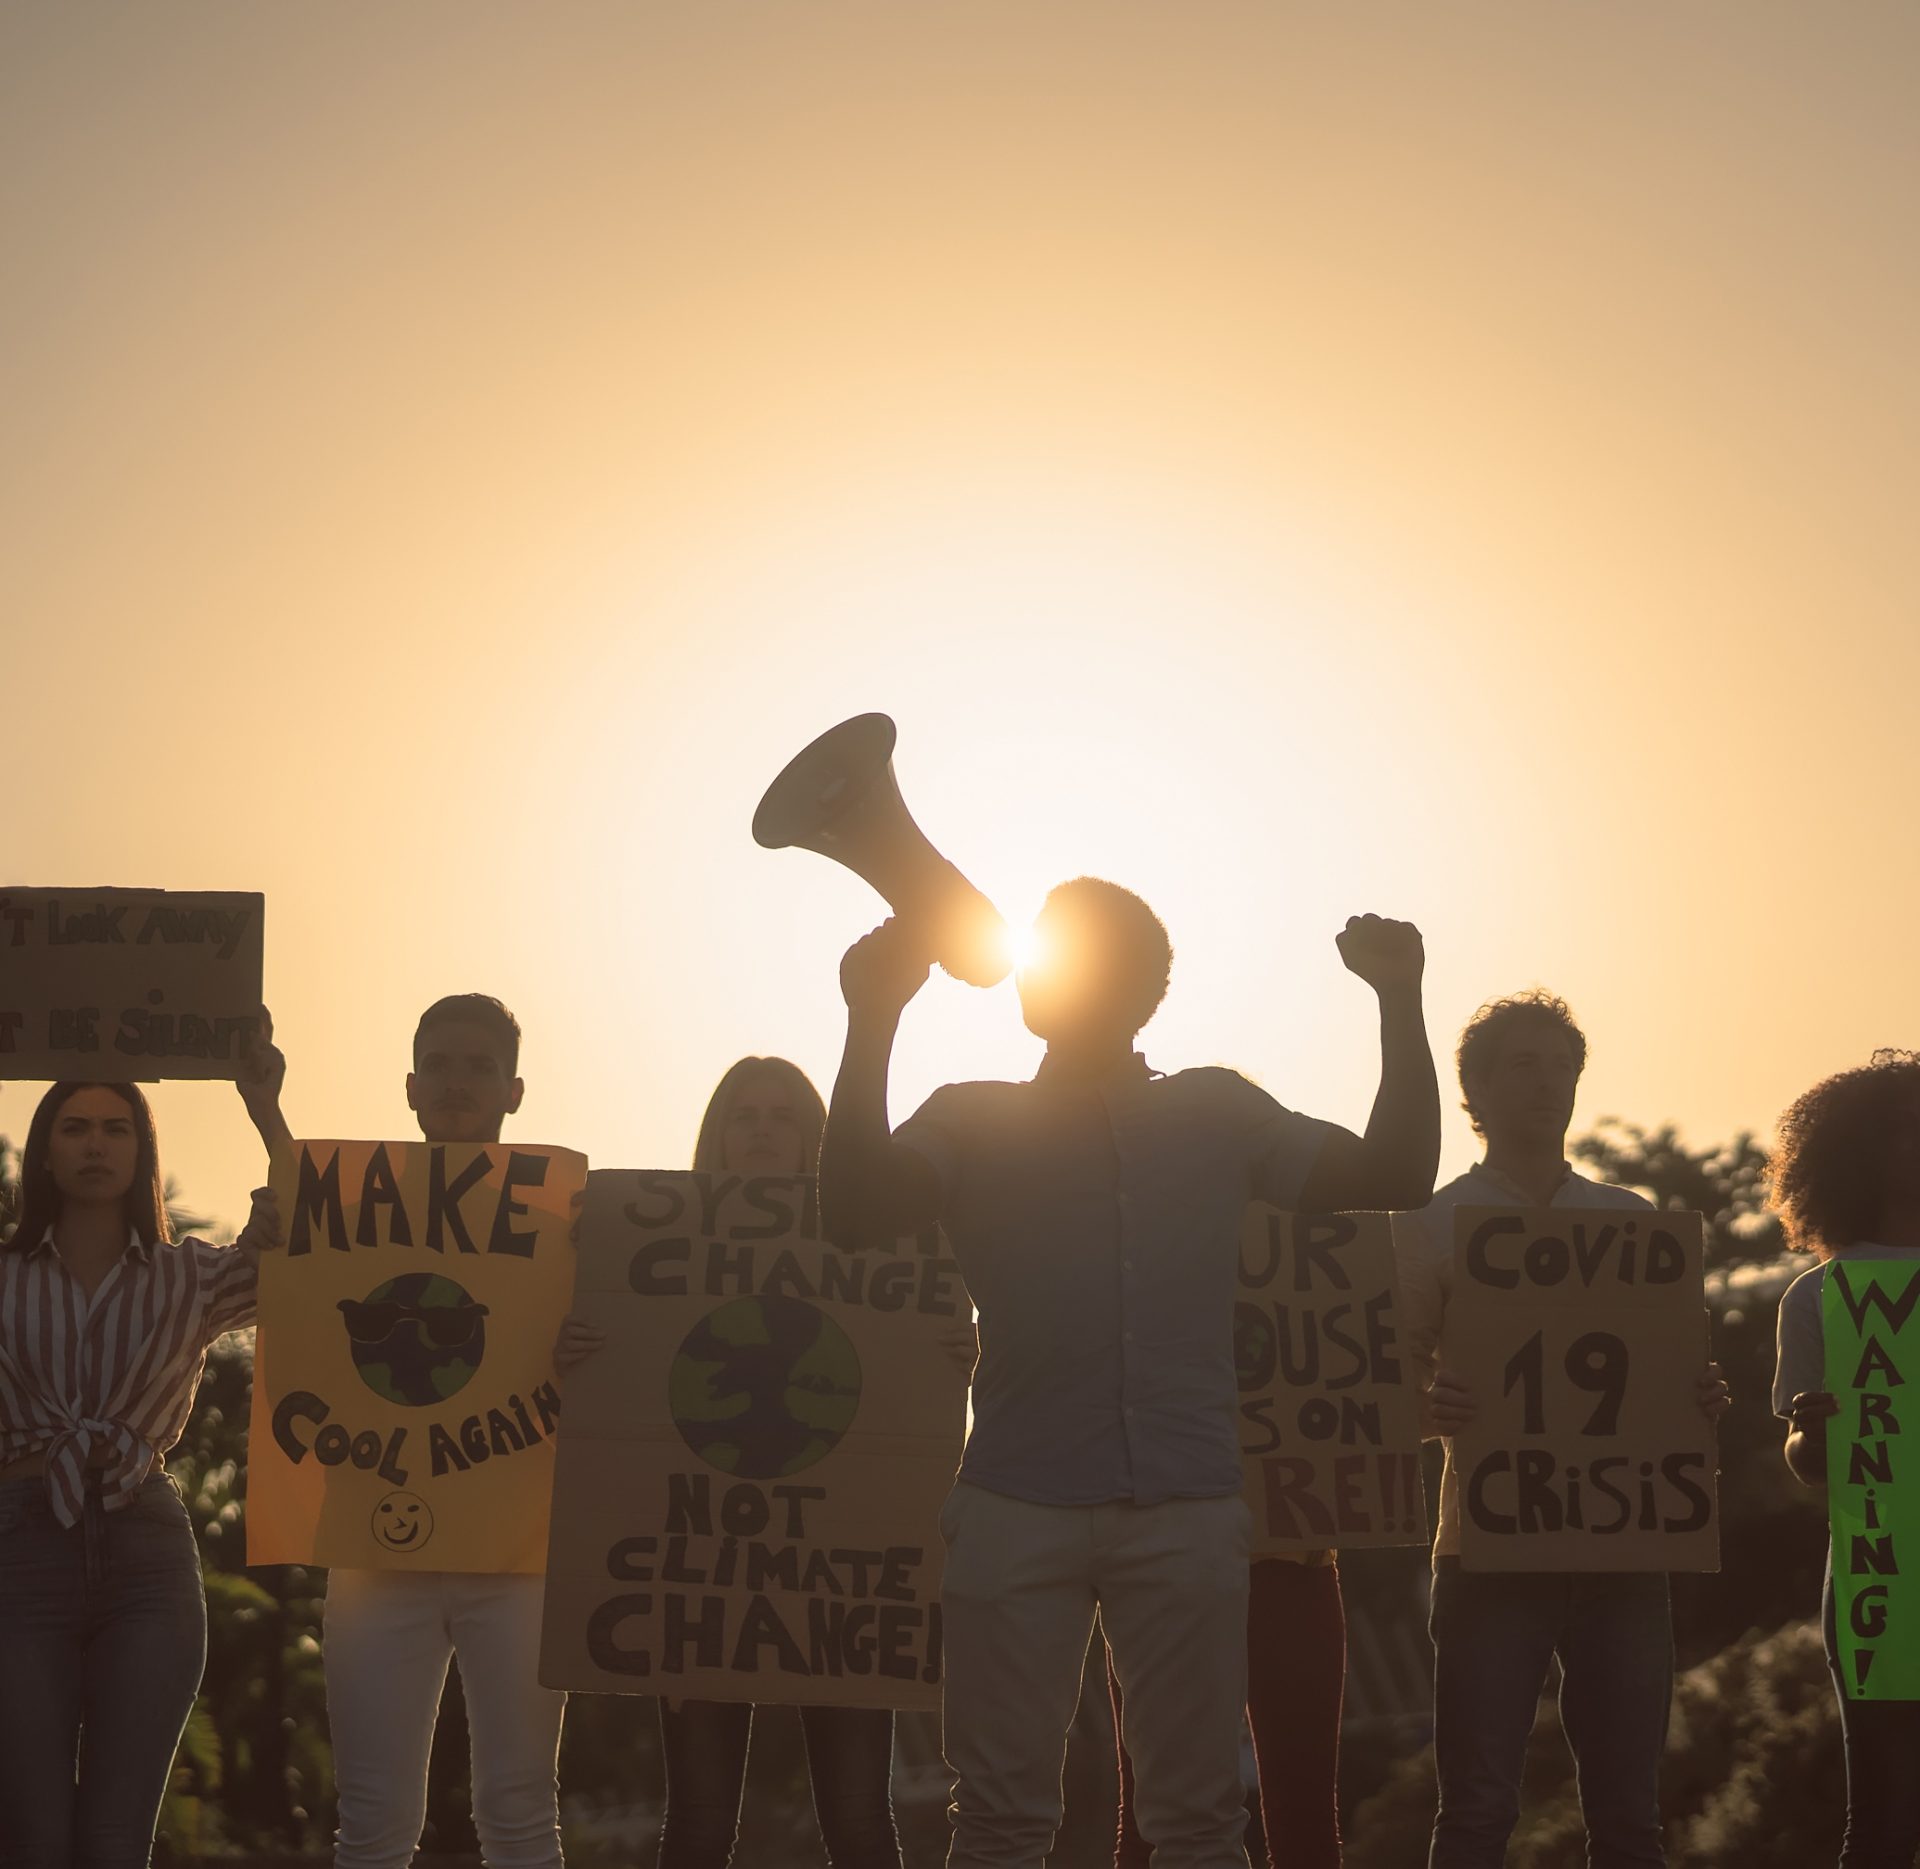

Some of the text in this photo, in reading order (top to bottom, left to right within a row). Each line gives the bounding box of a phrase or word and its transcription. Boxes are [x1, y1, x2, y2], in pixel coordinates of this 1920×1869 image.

[49, 1007, 100, 1053] BE
[288, 1141, 551, 1260] MAKE
[628, 1237, 963, 1317] CHANGE
[1238, 1213, 1358, 1292] UR
[1297, 1396, 1383, 1446] ON
[1504, 1329, 1630, 1437] 19
[664, 1473, 826, 1539] NOT
[586, 1592, 943, 1685] CHANGE!
